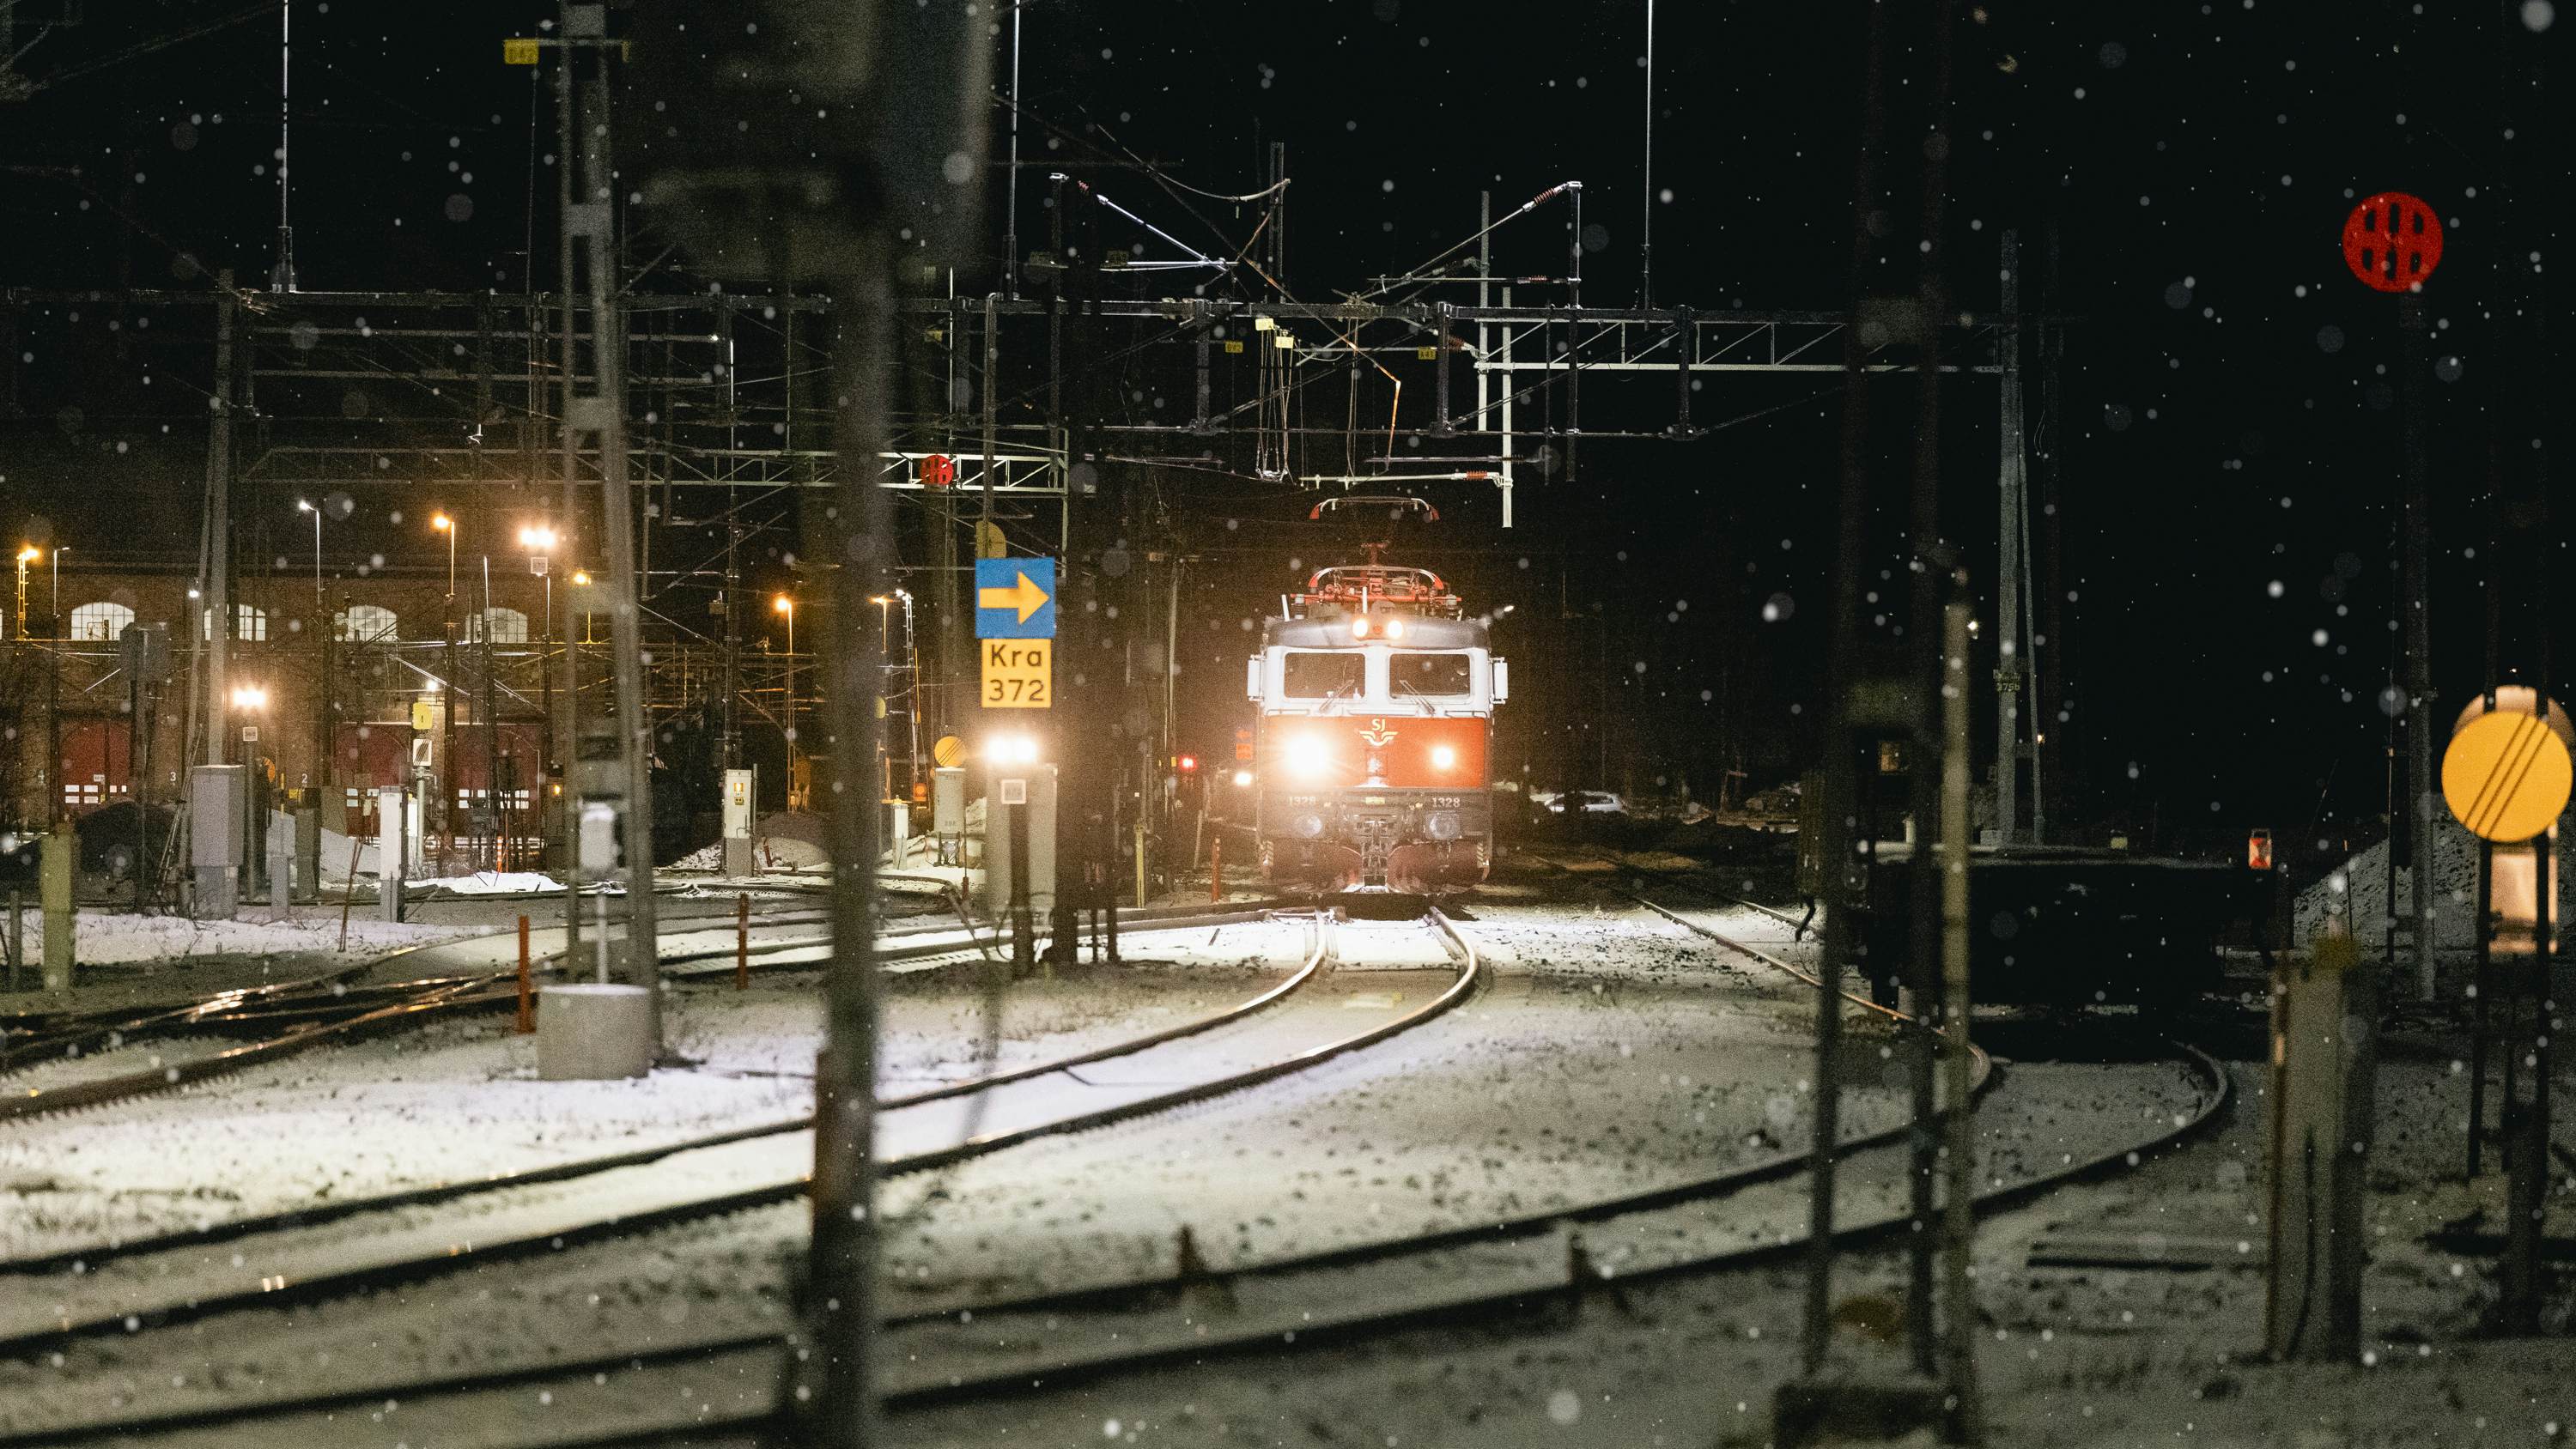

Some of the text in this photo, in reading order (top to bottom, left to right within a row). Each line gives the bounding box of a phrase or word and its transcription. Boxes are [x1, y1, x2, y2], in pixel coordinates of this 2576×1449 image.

[990, 644, 1042, 667] Kra
[988, 679, 1044, 702] 372
[1371, 718, 1386, 732] SJ
[170, 771, 177, 782] 3
[301, 773, 308, 784] 2
[1431, 797, 1461, 808] 1328
